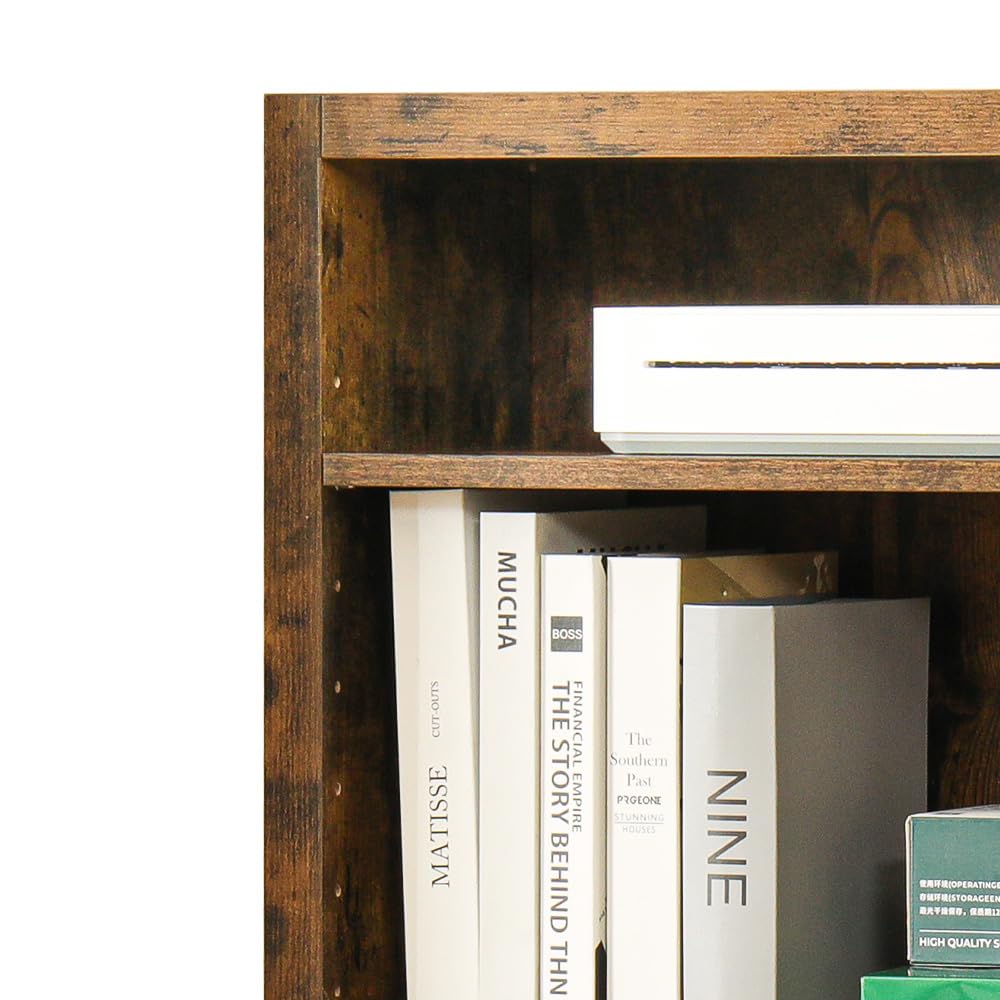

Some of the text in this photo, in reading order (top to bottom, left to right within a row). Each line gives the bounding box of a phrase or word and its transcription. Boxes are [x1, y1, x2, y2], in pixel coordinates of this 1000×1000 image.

[498, 552, 517, 650] MUCHA
[552, 628, 583, 640] BOSS
[431, 680, 440, 738] CUT-OUTS
[625, 732, 652, 746] The
[572, 680, 583, 833] FINANCIAL EMPIRE
[609, 751, 668, 767] Southern
[627, 773, 651, 787] Past
[614, 813, 664, 822] STUNNING
[428, 765, 450, 888] MATISSE
[622, 825, 656, 834] HOUSES
[550, 680, 570, 995] THE STORY BEHIND THN
[706, 769, 748, 907] NINE
[919, 937, 946, 947] HIGH
[947, 938, 992, 949] QUALITY
